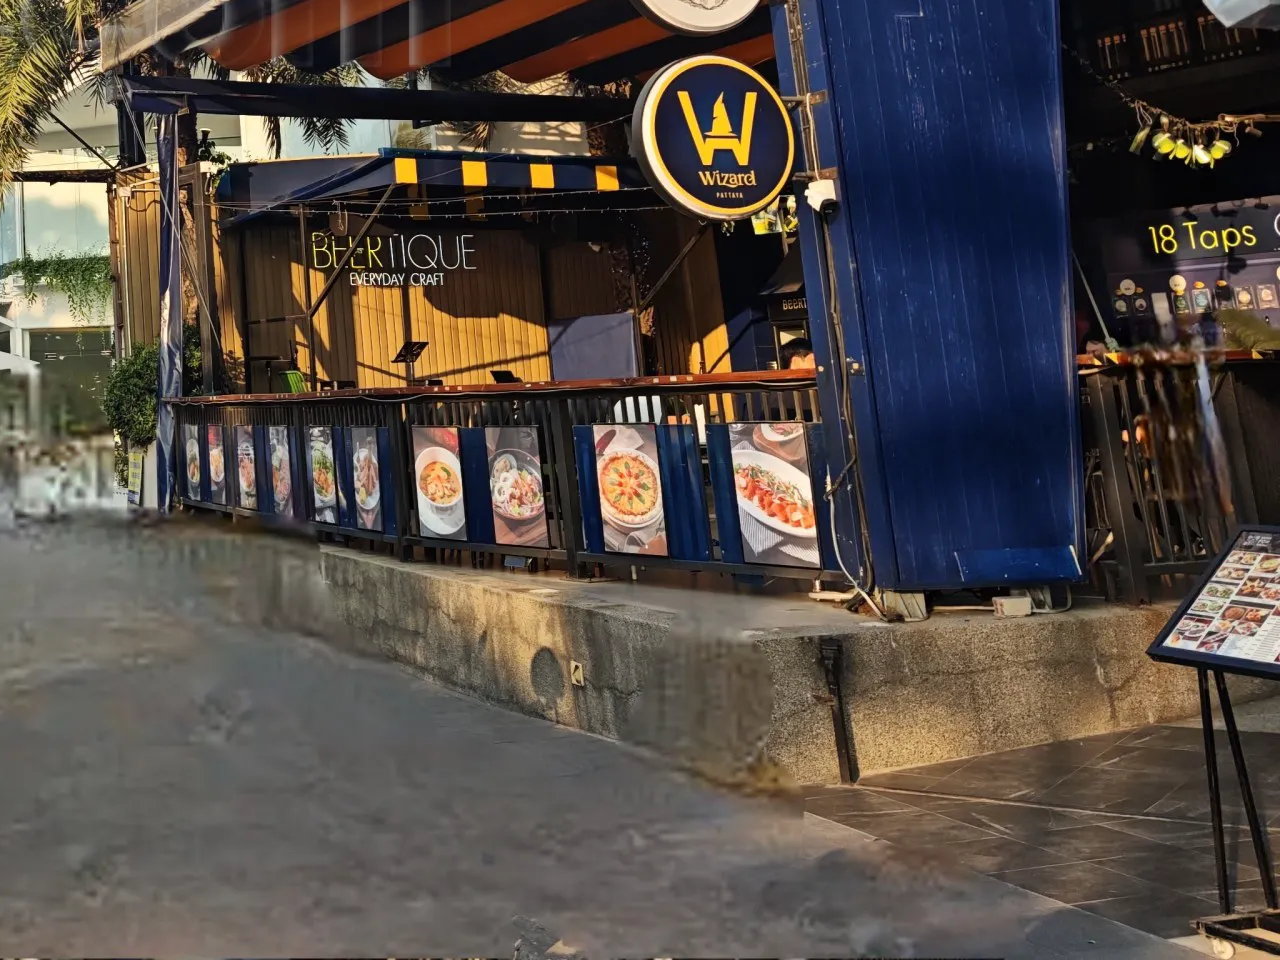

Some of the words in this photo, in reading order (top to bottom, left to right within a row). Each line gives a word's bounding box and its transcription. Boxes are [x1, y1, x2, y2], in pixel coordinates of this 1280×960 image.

[698, 170, 757, 188] Wizard
[1148, 224, 1178, 254] 18
[1182, 221, 1257, 253] Taps
[350, 272, 405, 286] EVERYDAY
[410, 272, 444, 286] CRAFT
